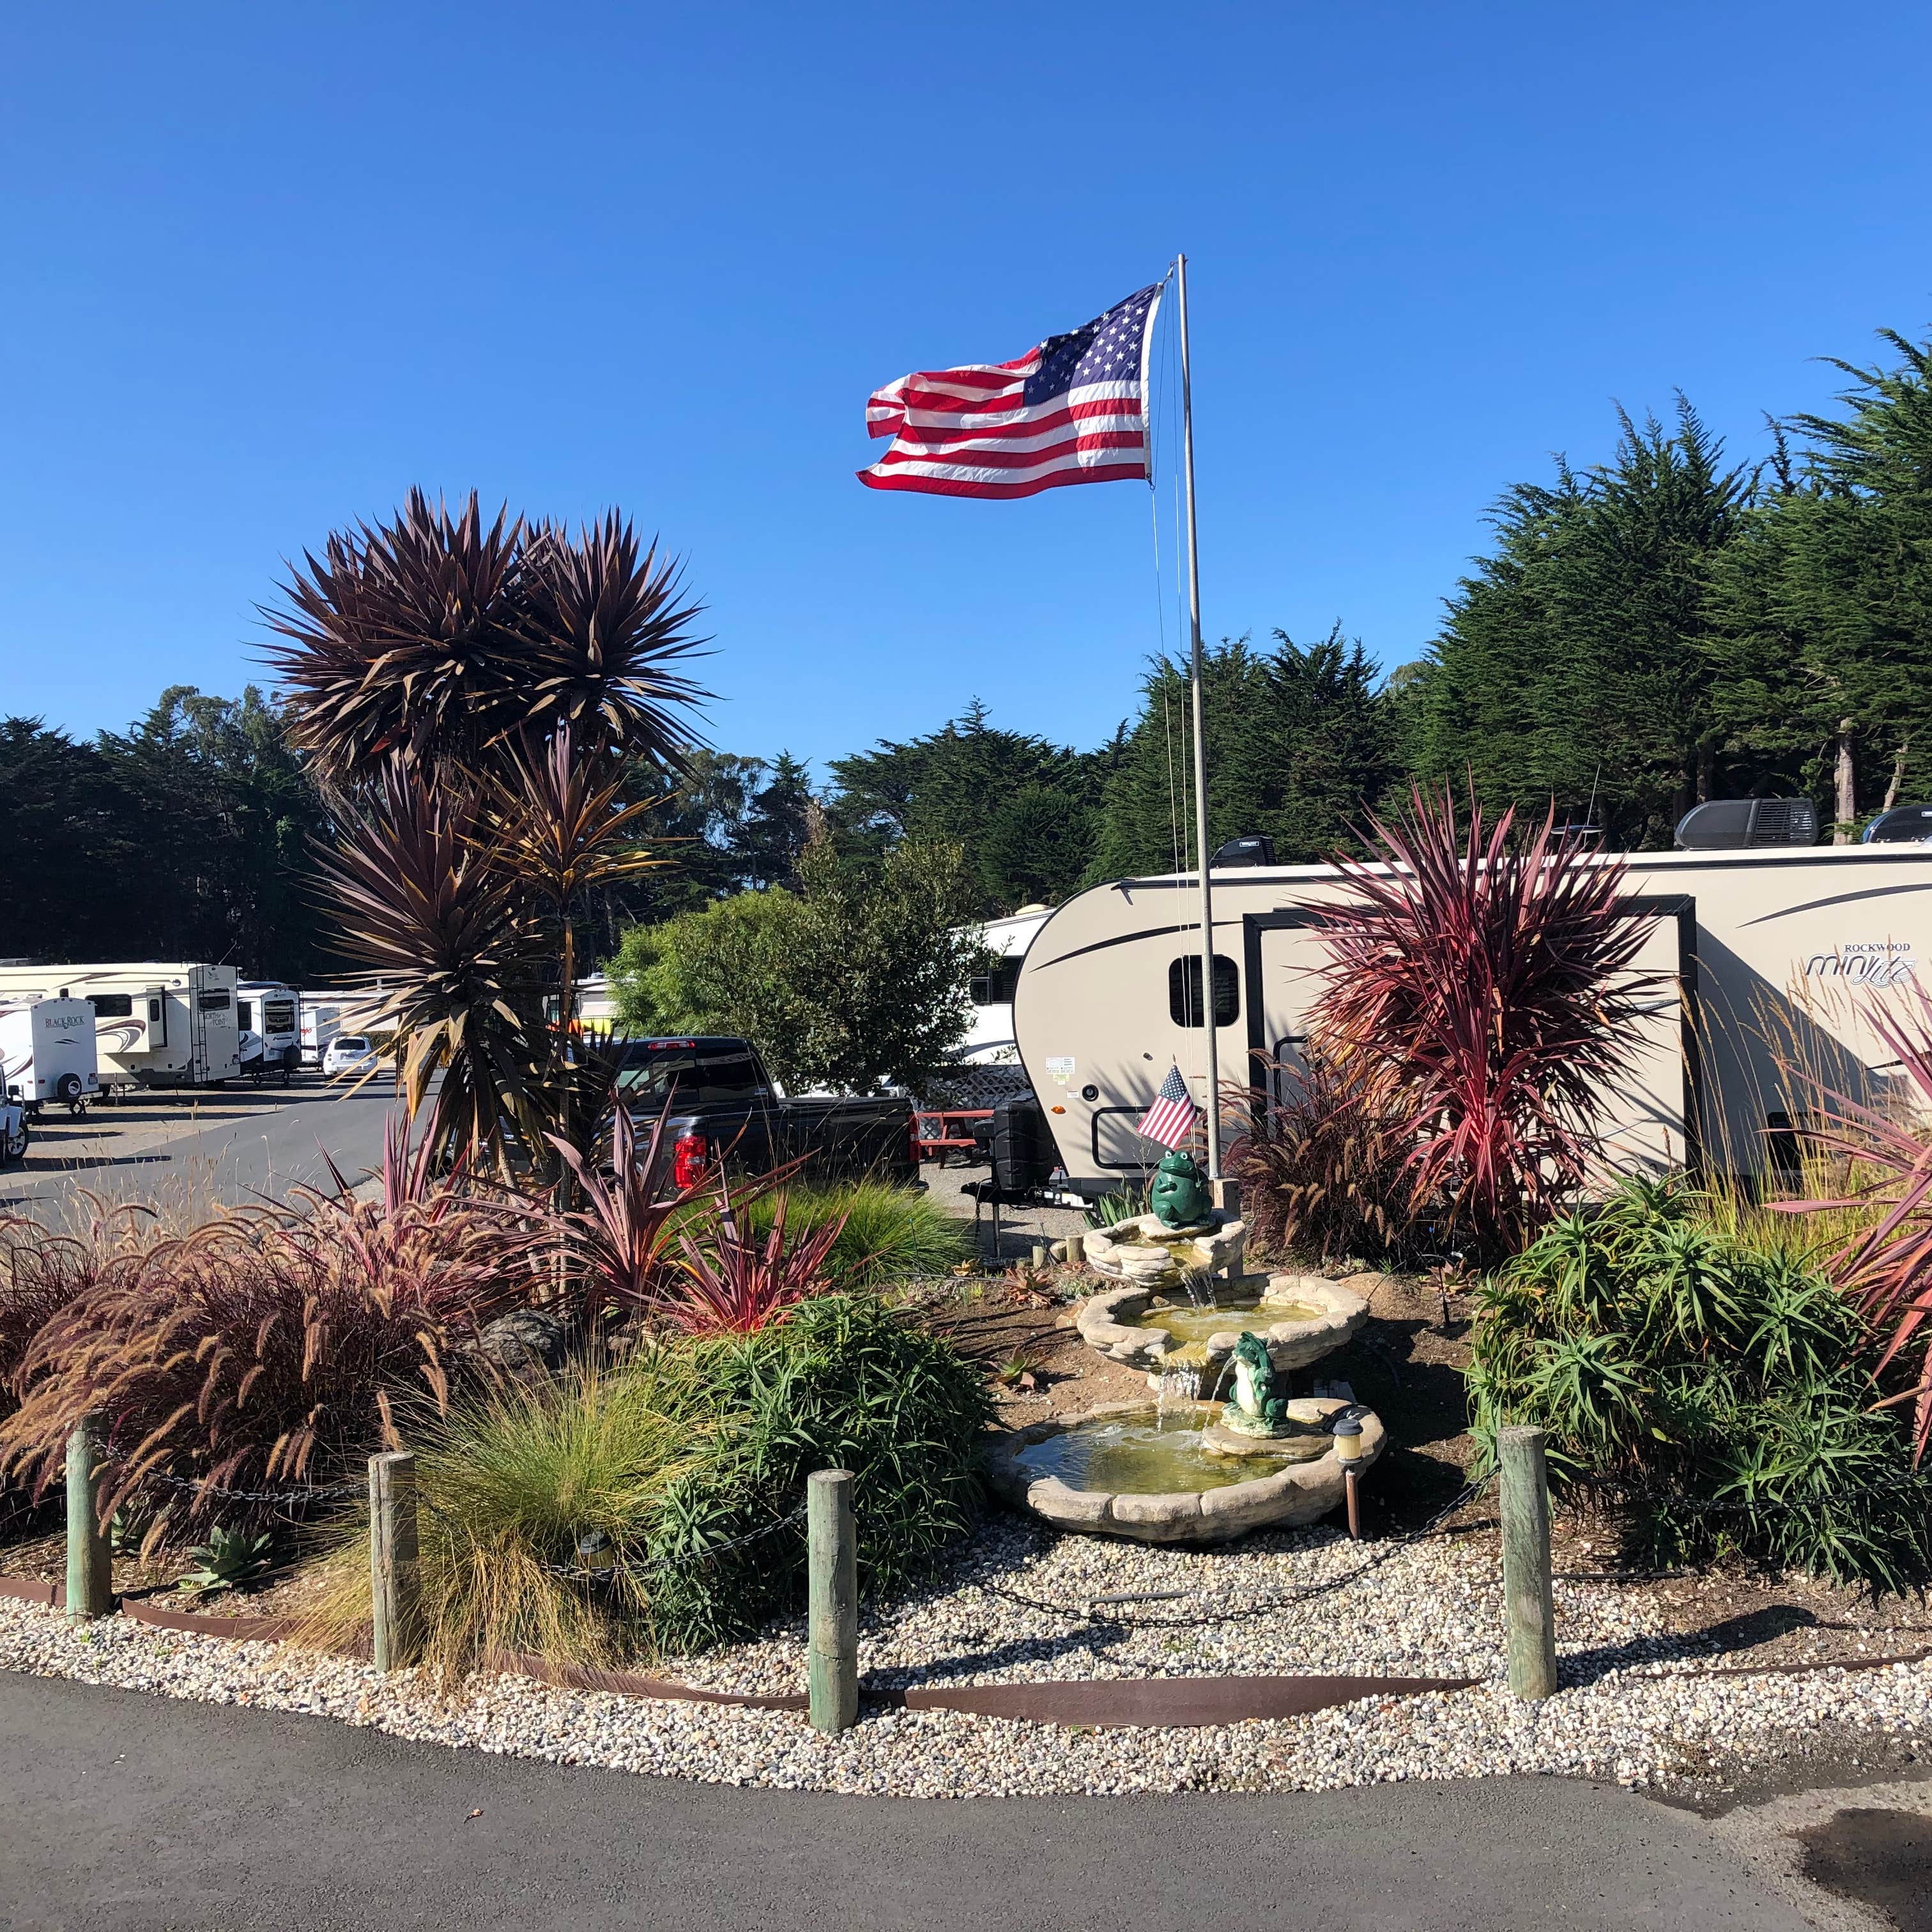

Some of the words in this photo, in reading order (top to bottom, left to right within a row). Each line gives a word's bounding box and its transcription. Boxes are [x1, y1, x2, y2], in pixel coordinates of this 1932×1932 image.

[1844, 943, 1911, 953] ROCKWOOD
[45, 1018, 66, 1028] BLACK
[66, 1016, 85, 1026] ROCK
